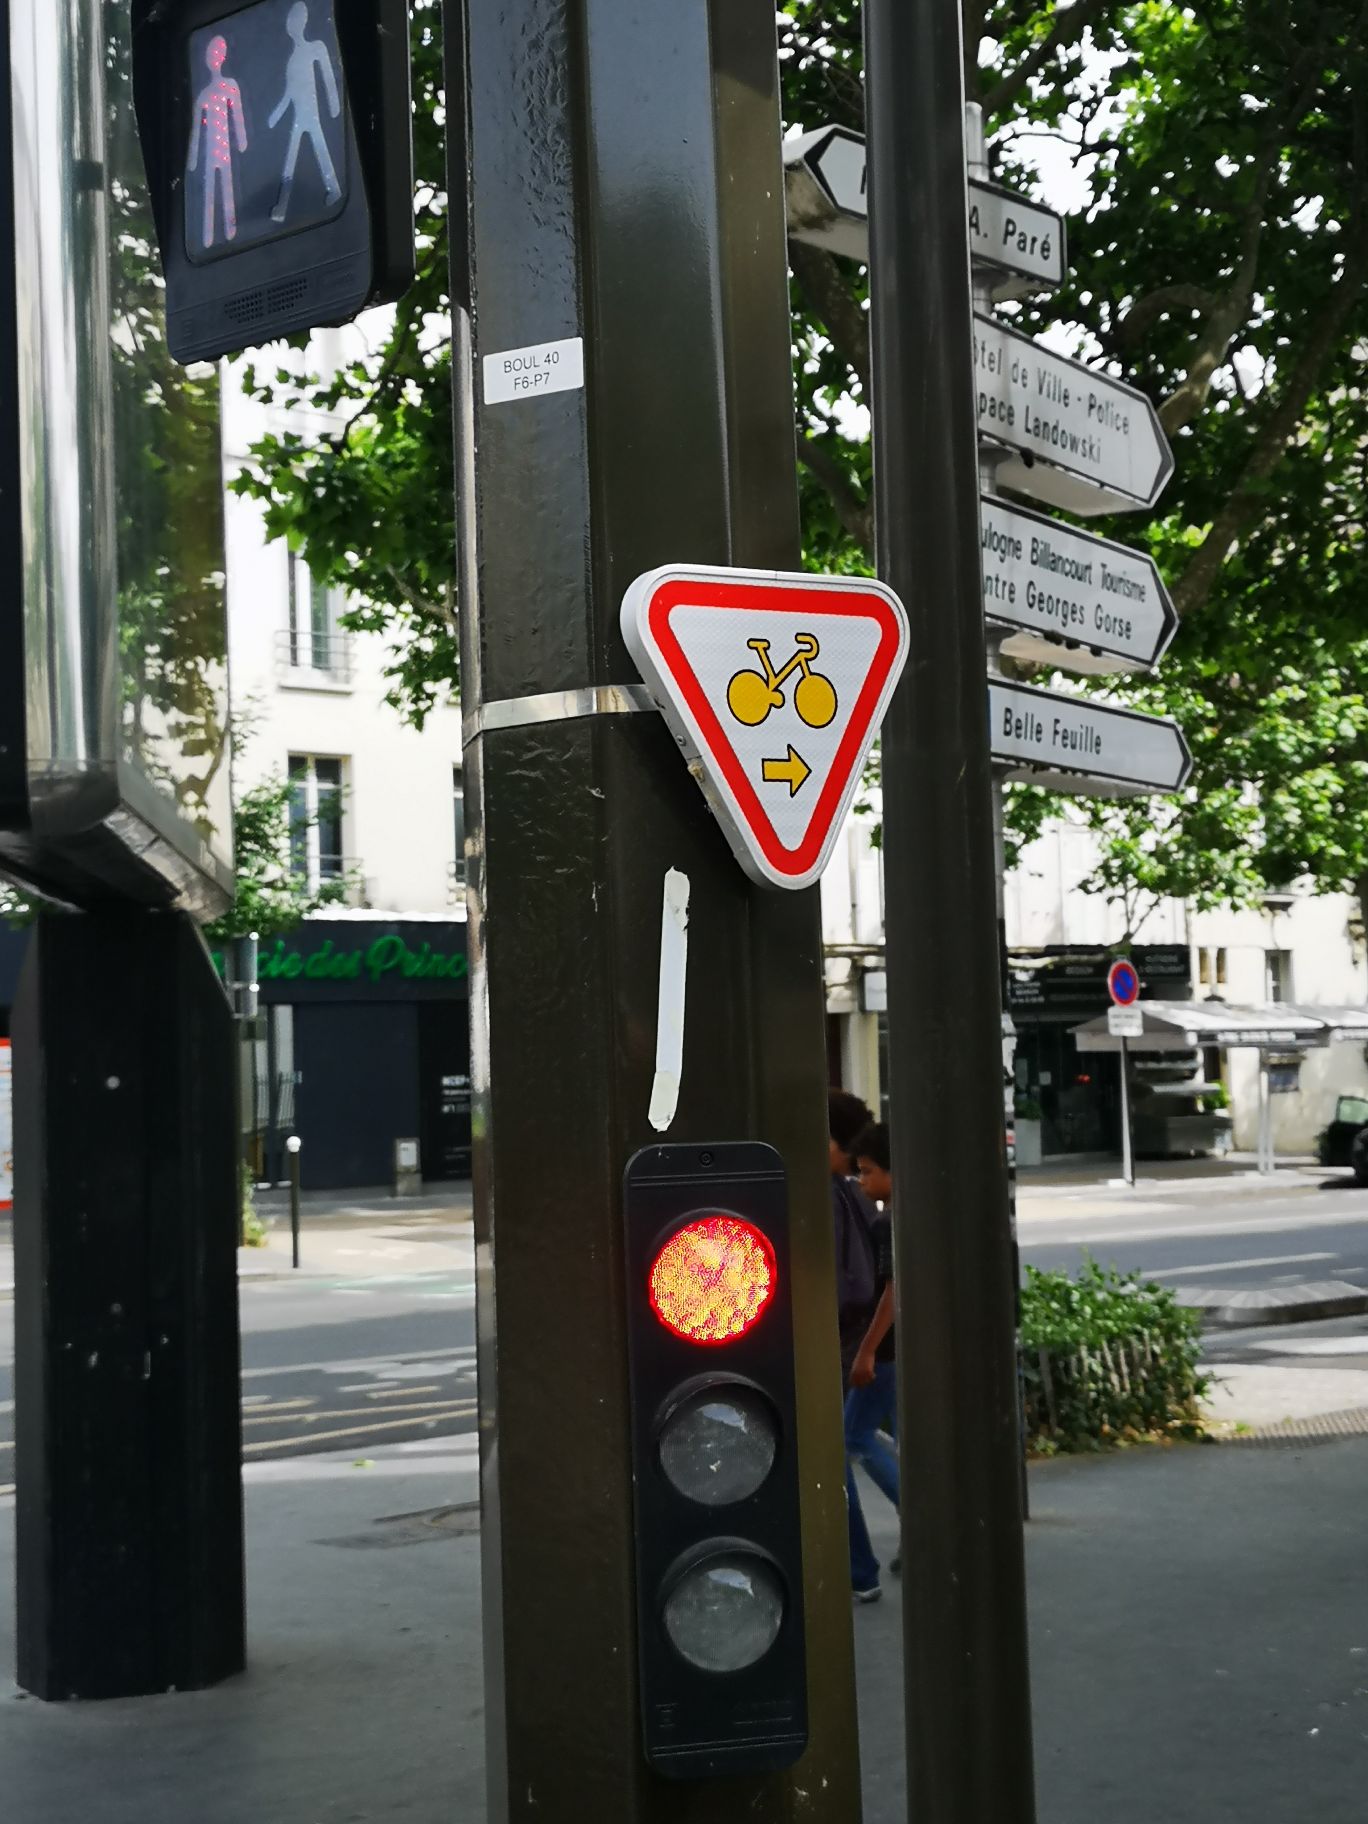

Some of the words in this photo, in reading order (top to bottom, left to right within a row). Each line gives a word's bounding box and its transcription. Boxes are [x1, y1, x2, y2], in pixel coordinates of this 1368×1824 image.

[1002, 217, 1051, 261] Paré
[503, 355, 541, 374] BOUL
[543, 351, 560, 365] 40
[513, 371, 551, 391] F6-P7
[1011, 356, 1028, 388] de
[1037, 367, 1070, 408] Ville
[1087, 392, 1130, 435] Police
[1024, 404, 1101, 464] Landowski
[1030, 536, 1093, 586] Billancourt
[1101, 562, 1147, 603] Tourisme
[1026, 580, 1086, 628] Georges
[1094, 603, 1132, 641] Gorse
[1003, 706, 1043, 743] Belle
[1052, 717, 1102, 755] Feuille
